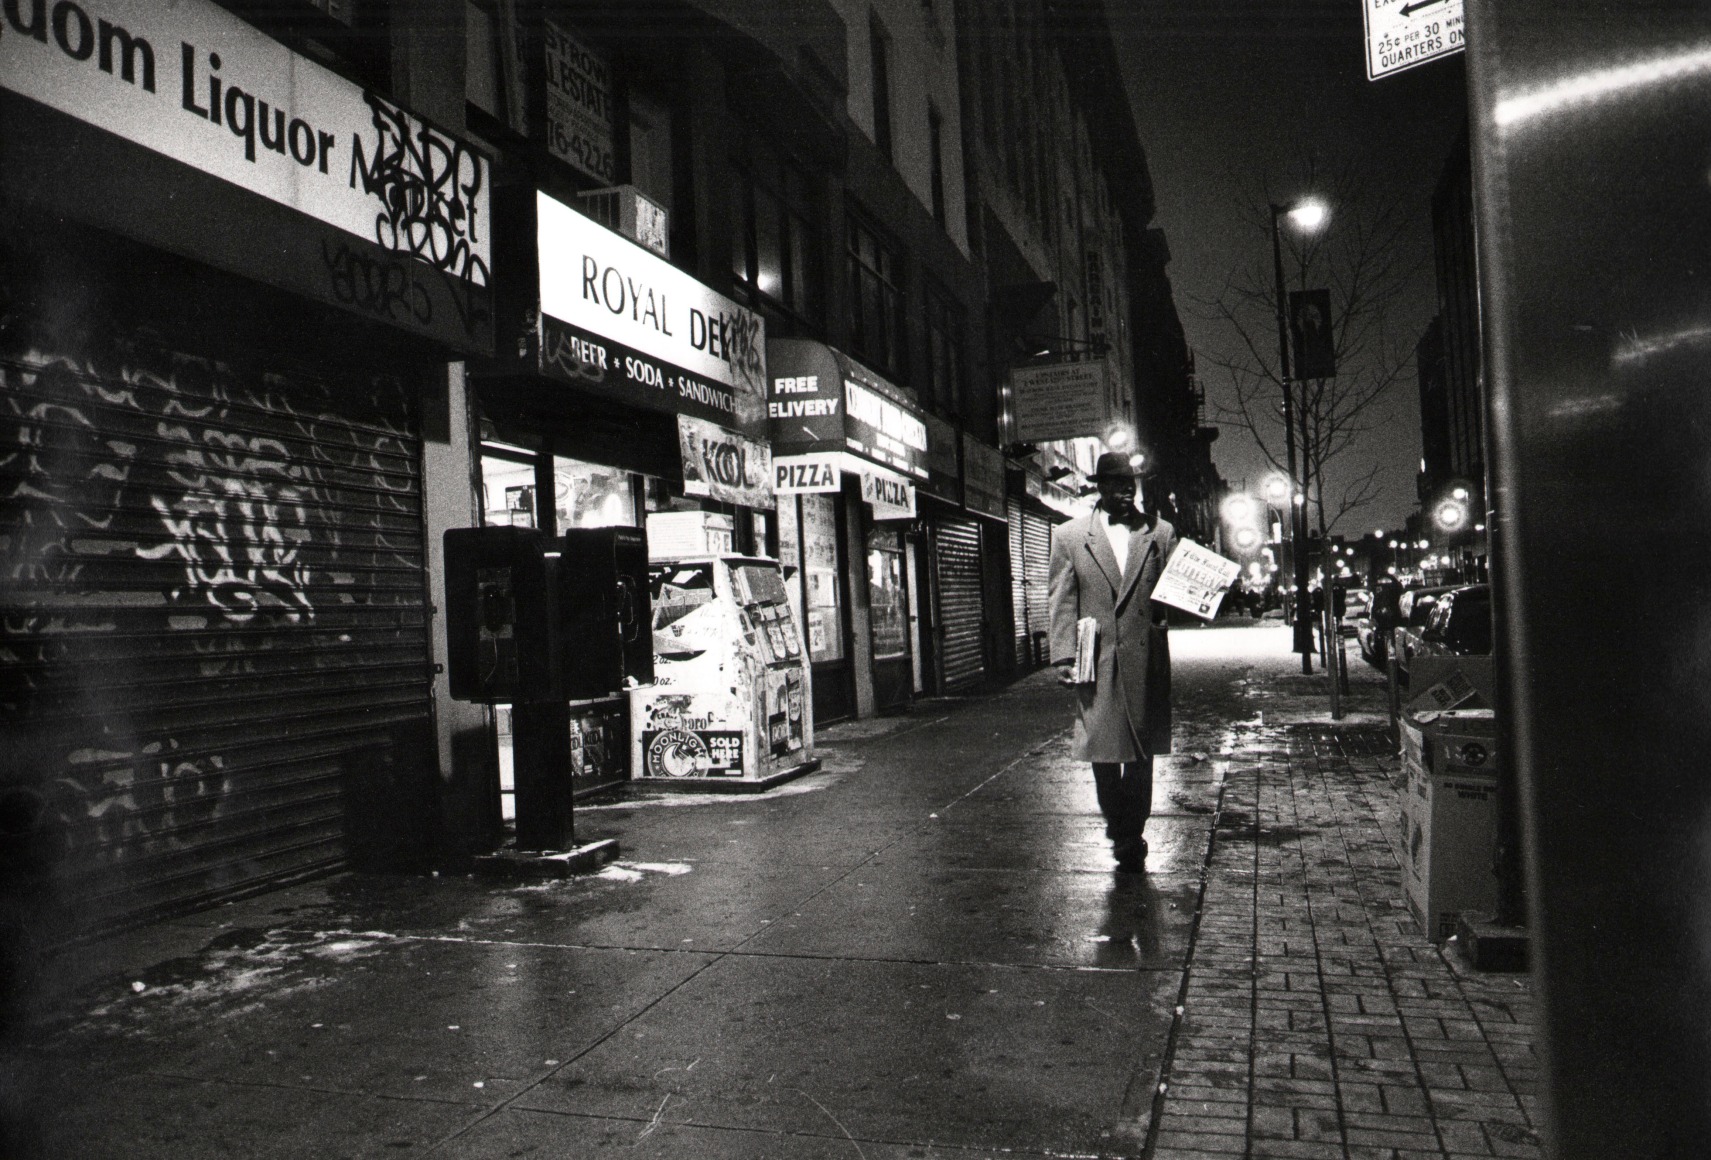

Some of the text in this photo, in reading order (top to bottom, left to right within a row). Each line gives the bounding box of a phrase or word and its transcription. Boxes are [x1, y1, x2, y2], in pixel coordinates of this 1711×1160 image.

[1404, 30, 1420, 43] PER
[1424, 22, 1440, 38] 30
[1381, 36, 1443, 68] QUARTERS
[181, 41, 335, 175] Liquor
[582, 254, 672, 337] ROYAL
[571, 336, 607, 370] BEER
[625, 356, 664, 389] SODA
[774, 376, 818, 394] FREE
[768, 398, 839, 418] ELIVERY
[776, 463, 834, 488] PIZZA
[874, 476, 909, 509] PIZZA
[710, 737, 740, 748] SOLD
[711, 749, 740, 759] HERE
